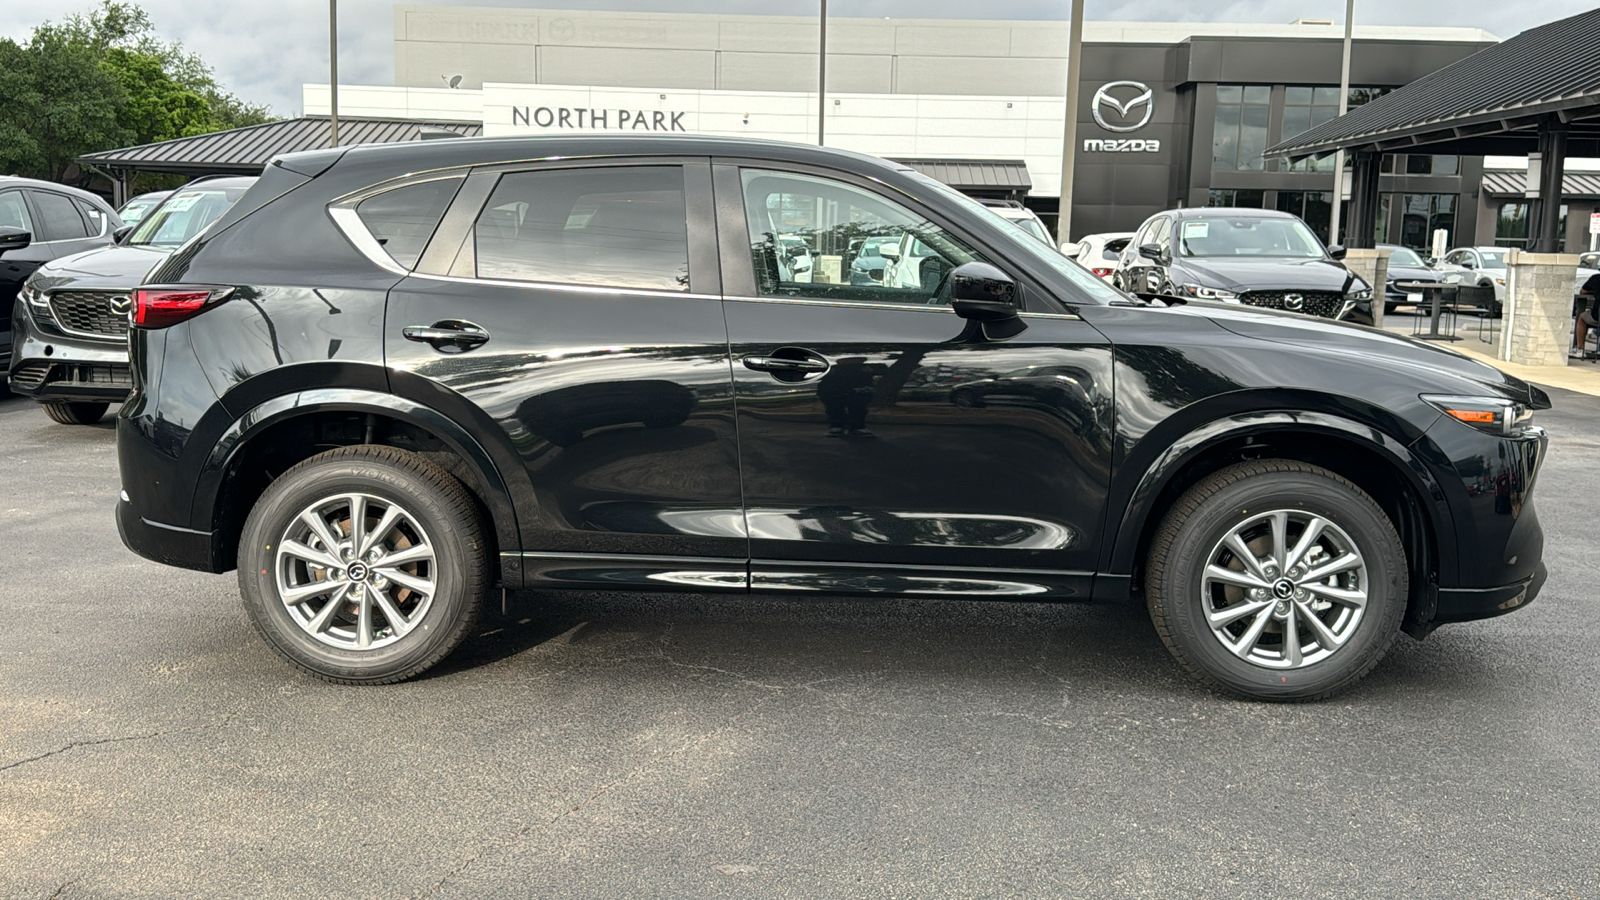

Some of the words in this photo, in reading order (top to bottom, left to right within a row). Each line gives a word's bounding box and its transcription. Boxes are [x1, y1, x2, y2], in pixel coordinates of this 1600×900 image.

[512, 105, 608, 130] NORTH
[618, 109, 686, 132] PARK
[1083, 139, 1161, 153] mazda
[350, 465, 453, 534] YOKOHAMA
